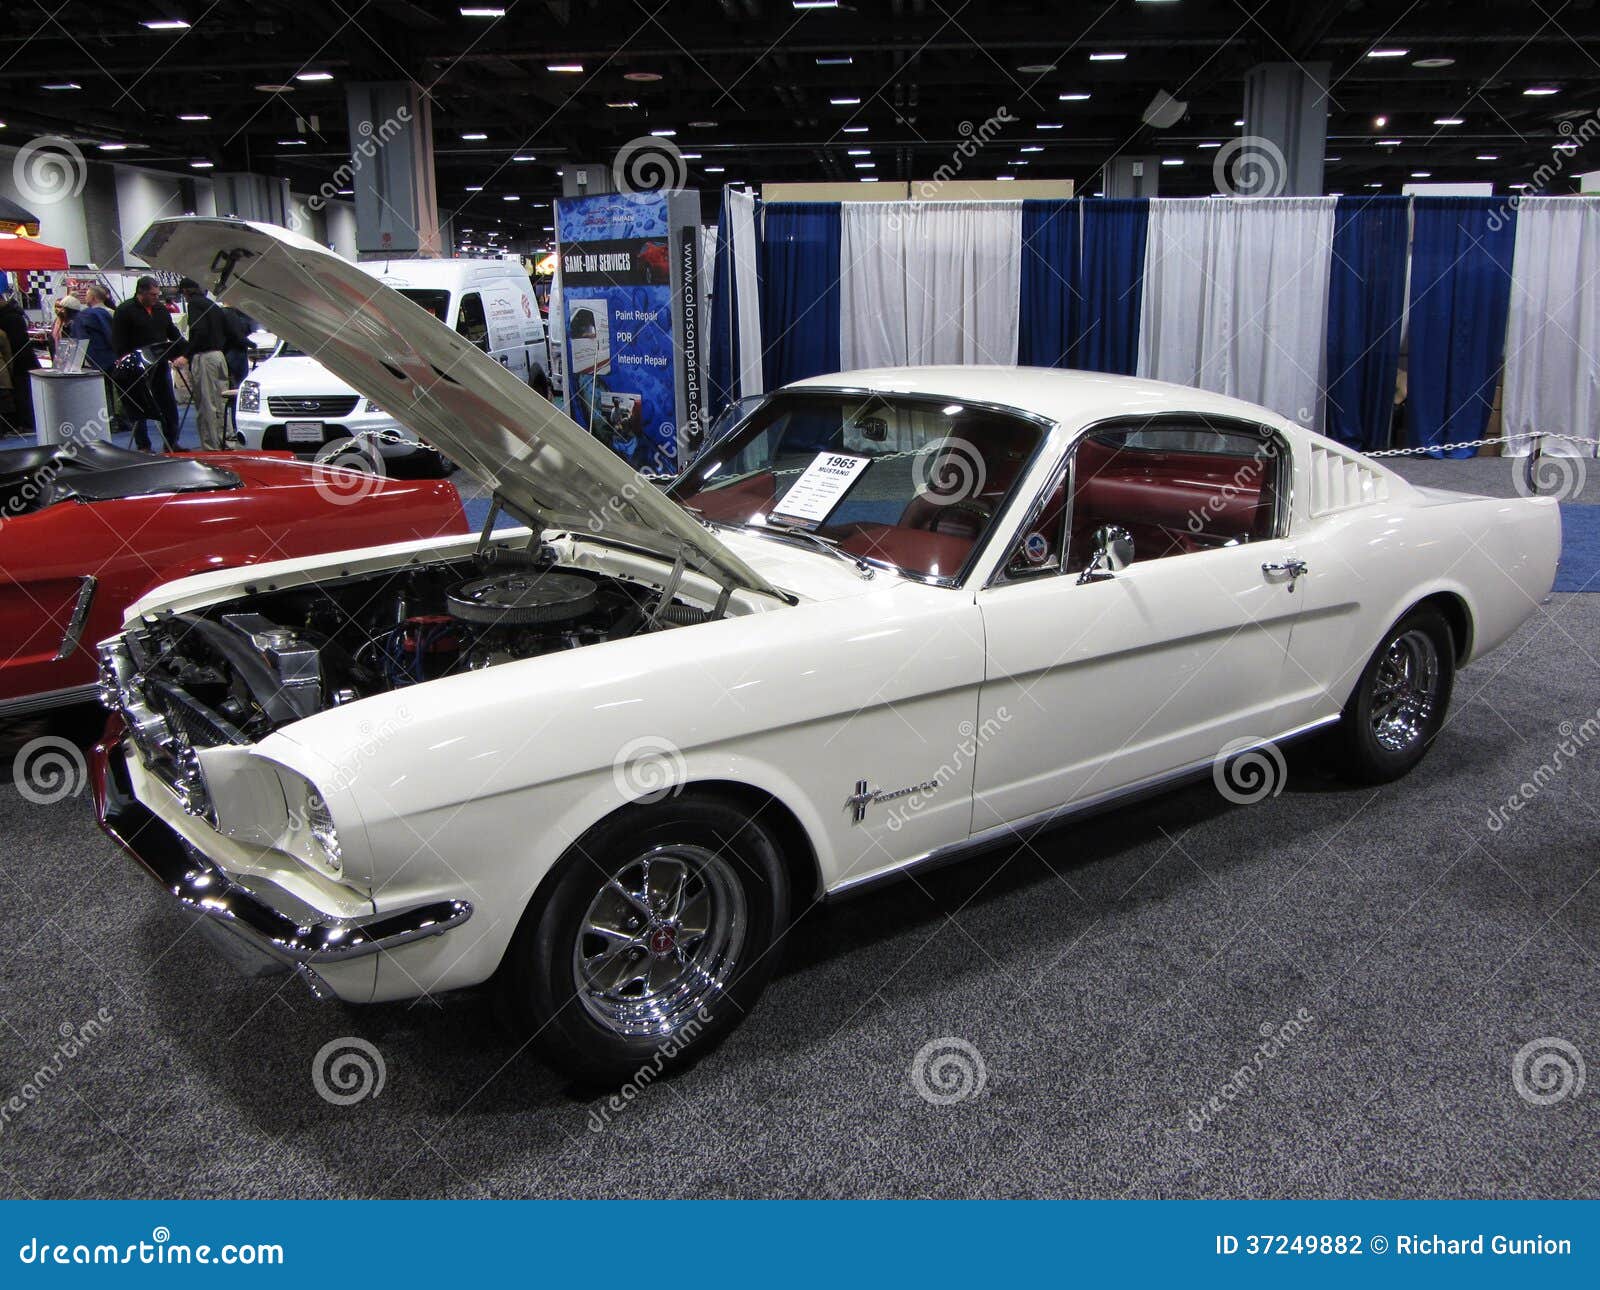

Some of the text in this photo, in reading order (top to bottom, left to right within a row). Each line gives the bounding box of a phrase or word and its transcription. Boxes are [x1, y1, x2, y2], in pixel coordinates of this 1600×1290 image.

[564, 252, 631, 273] SAME-DAY SERVICES
[615, 310, 658, 323] Paint Repair
[616, 332, 632, 342] PDR
[684, 243, 700, 434] www.colorsonparade.com
[617, 354, 668, 367] Interior Repair
[826, 456, 858, 469] 1965
